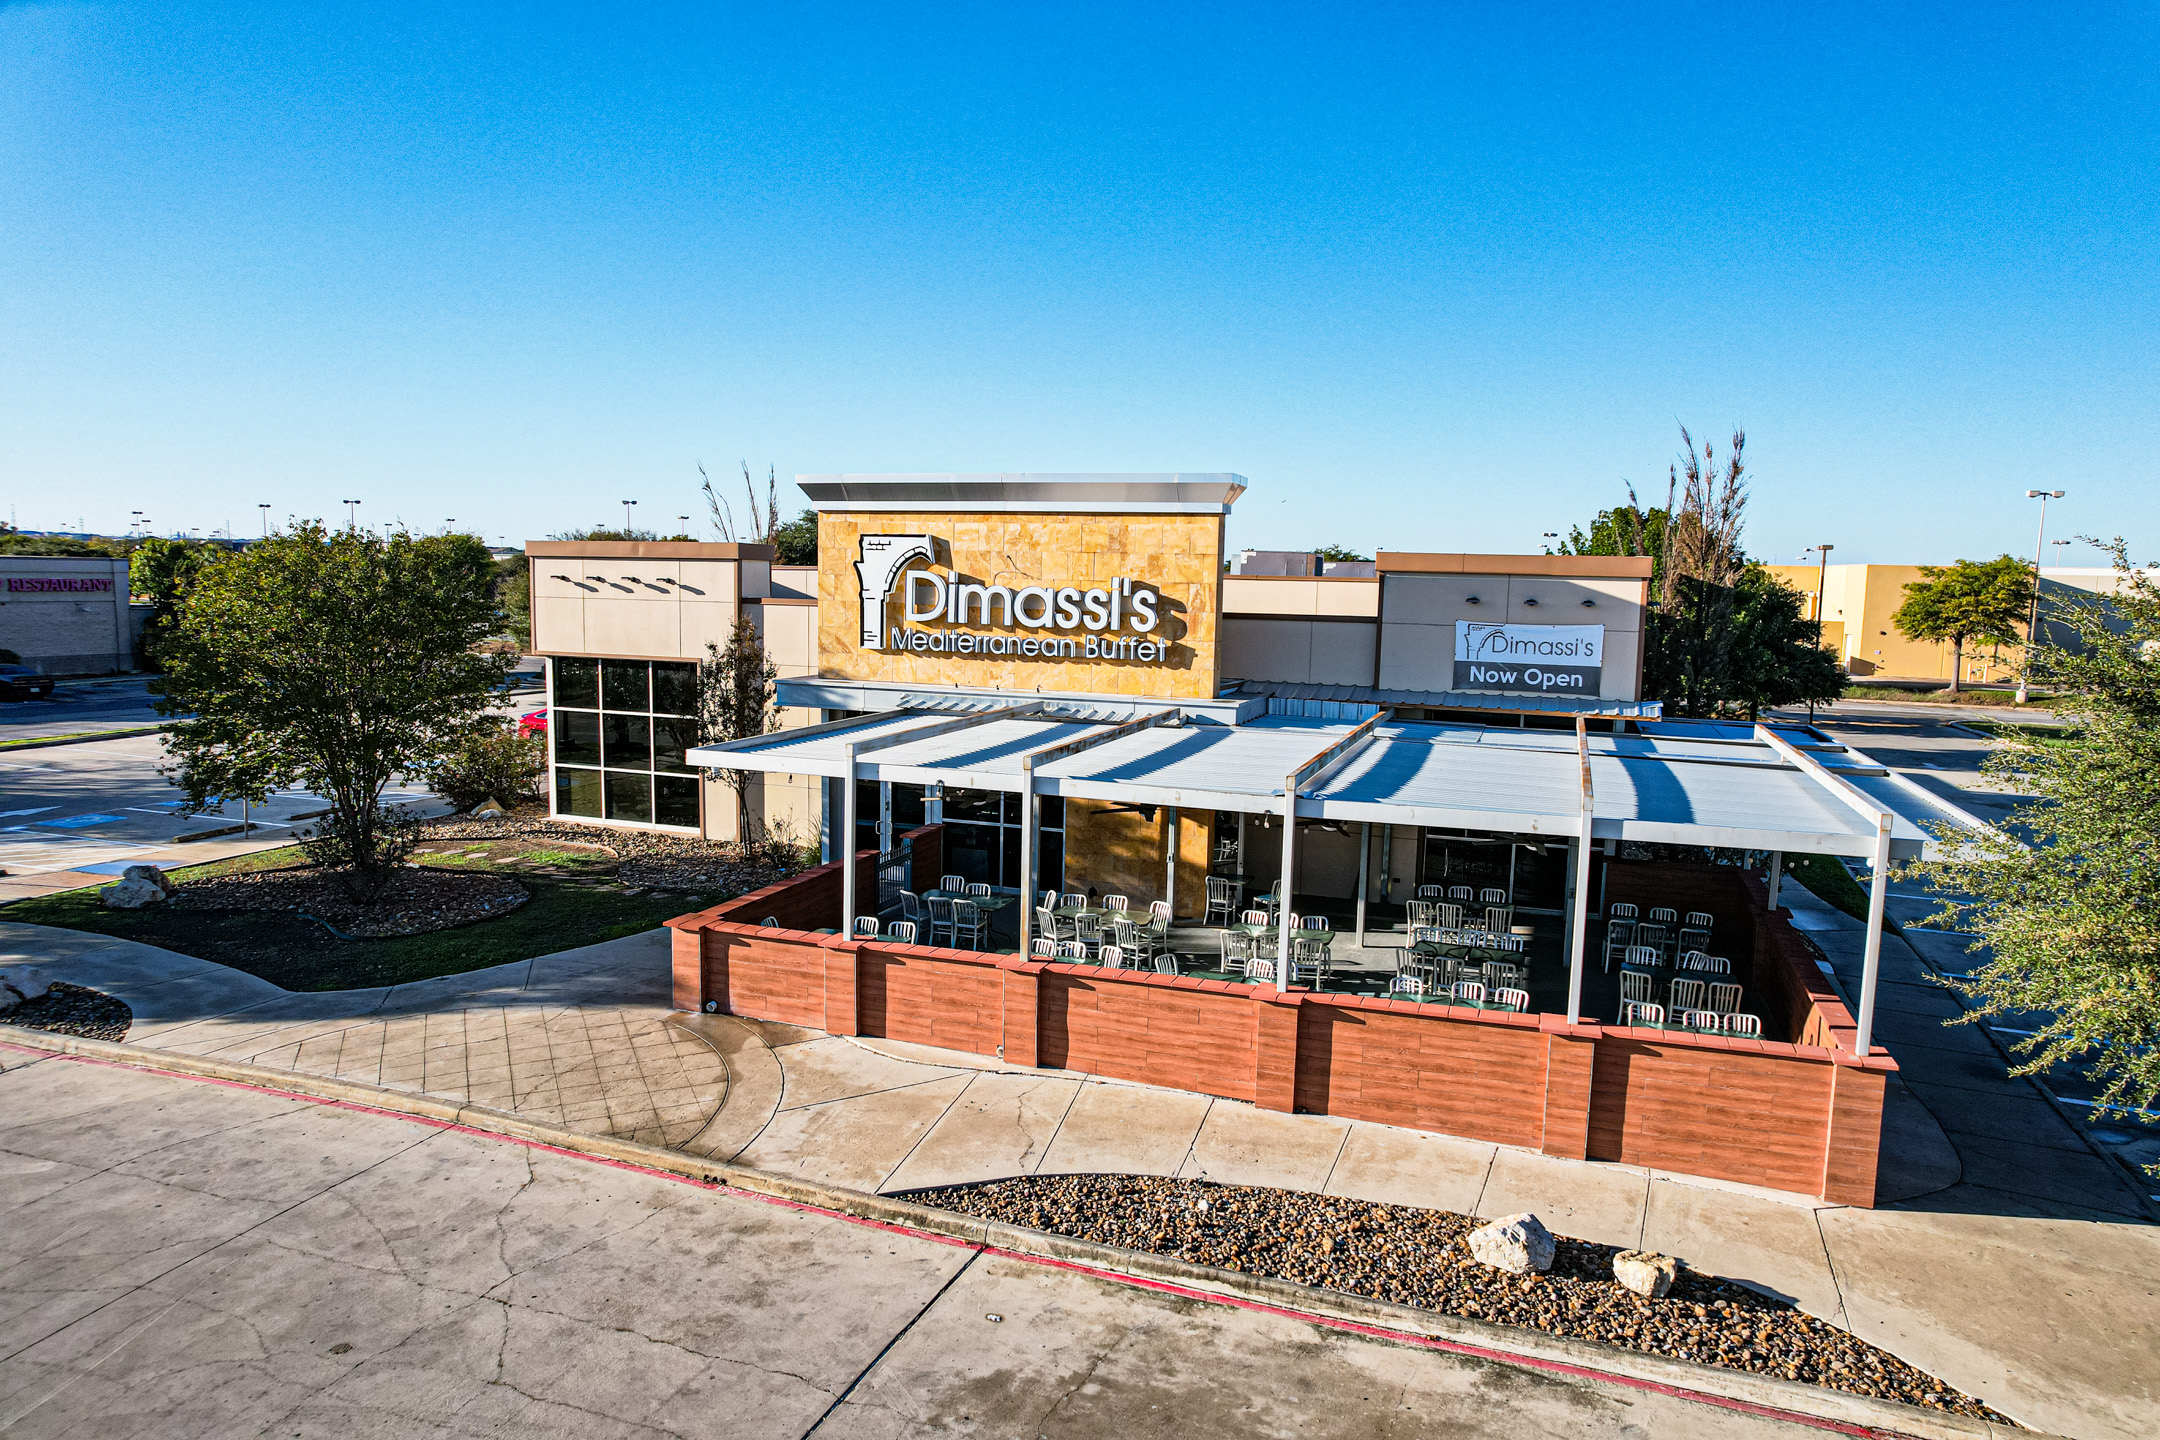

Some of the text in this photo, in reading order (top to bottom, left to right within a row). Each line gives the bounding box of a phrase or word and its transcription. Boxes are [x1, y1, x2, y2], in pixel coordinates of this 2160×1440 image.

[8, 578, 112, 592] RESTAURANT
[905, 570, 1157, 632] Dimassi's
[891, 627, 1166, 662] Mediterranean Buffet
[1492, 635, 1593, 656] Dimassi's
[1470, 666, 1583, 689] Now Open
